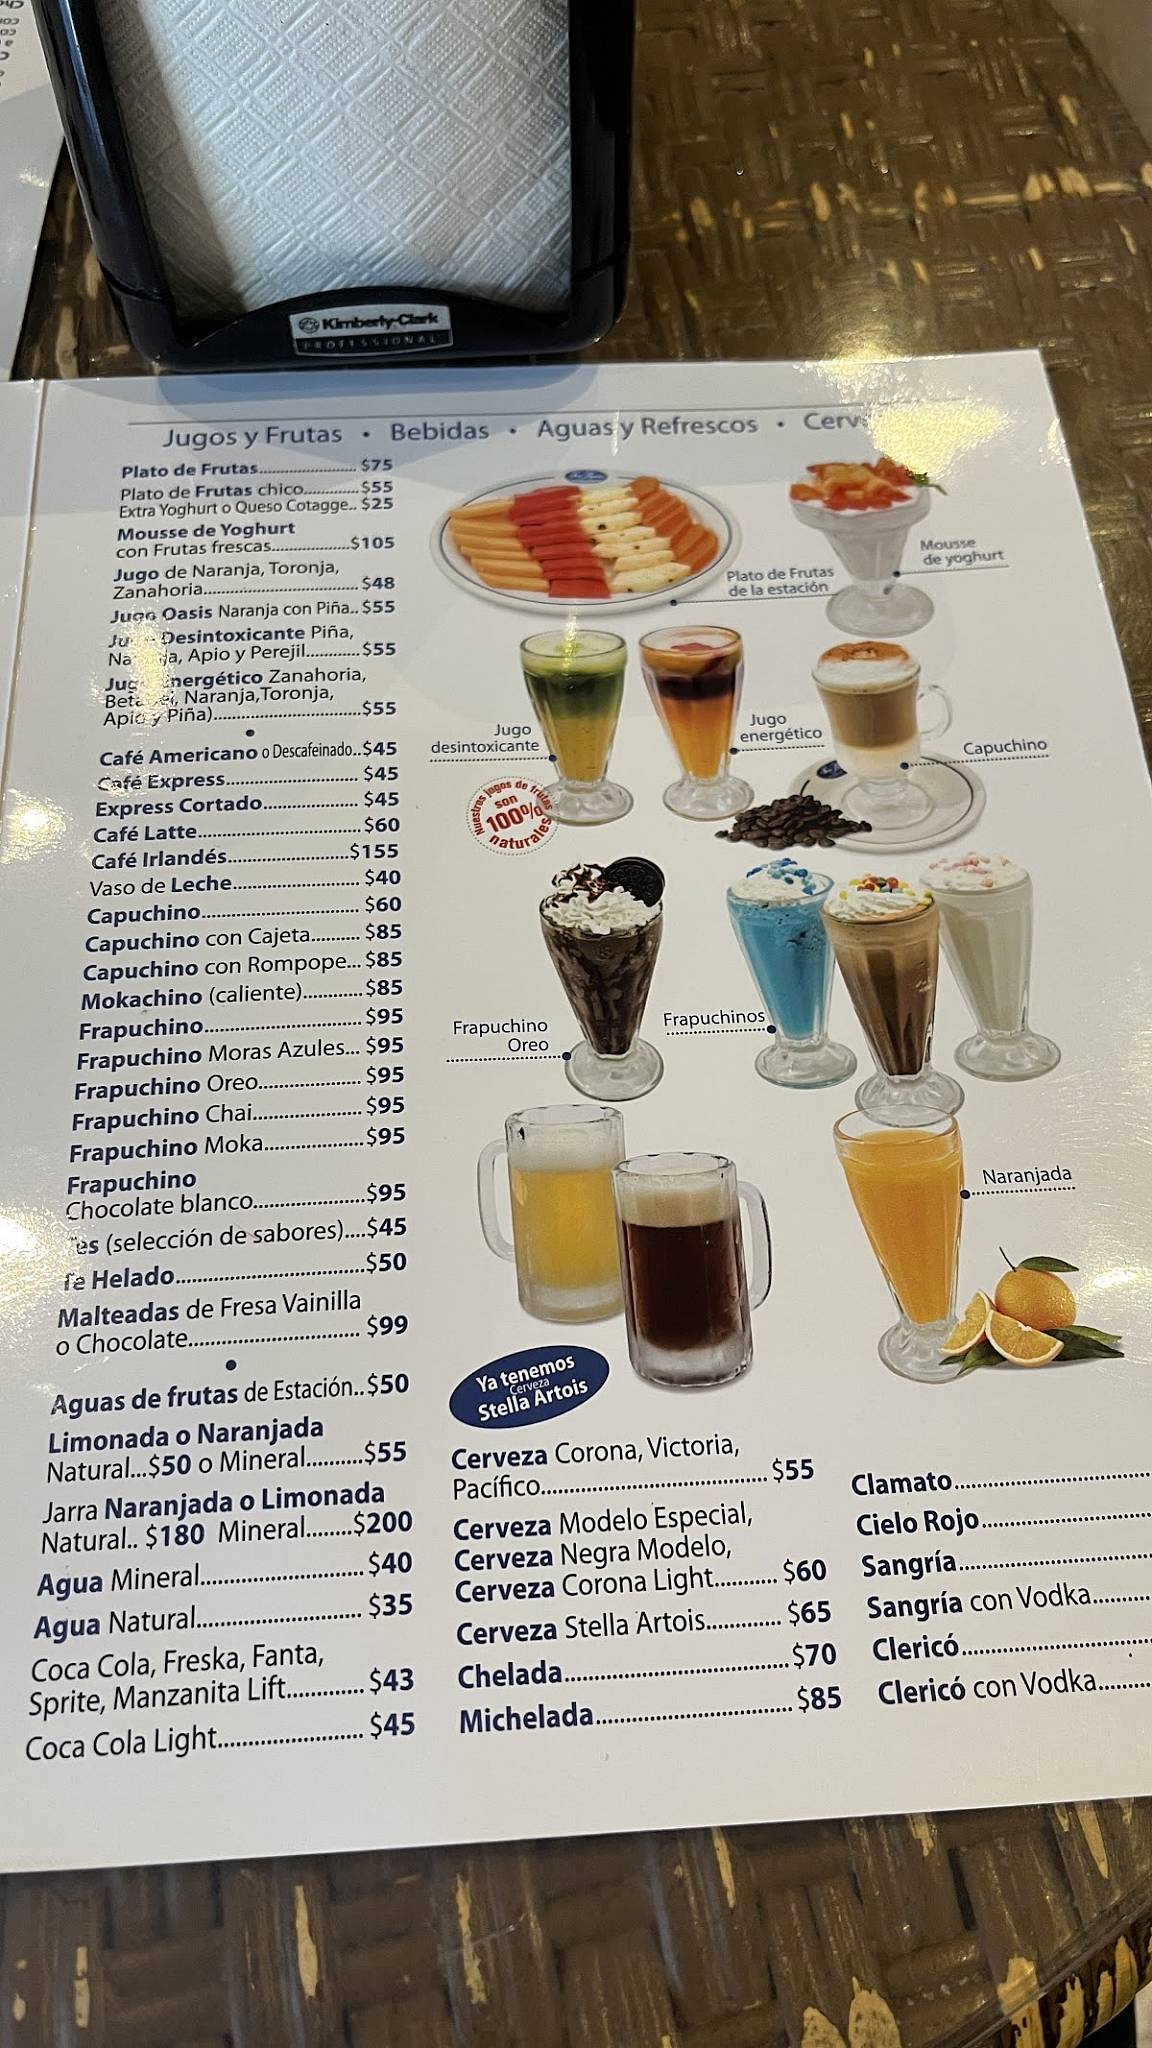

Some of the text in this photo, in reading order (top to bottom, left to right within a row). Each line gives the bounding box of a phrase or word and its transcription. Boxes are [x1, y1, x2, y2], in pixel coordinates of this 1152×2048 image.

[323, 312, 439, 330] Kimberly-Clark
[162, 429, 237, 450] Jugos
[244, 432, 257, 449] y
[265, 425, 342, 443] Frutas
[390, 422, 489, 441] Bebidas
[538, 418, 613, 440] Aguas
[619, 421, 634, 440] y
[642, 415, 758, 435] Refrescos
[121, 459, 393, 479] Plato de Frutas $75
[120, 481, 393, 501] Plato de Frutas chico $55
[119, 498, 393, 519] Extra Yoghurt o Queso Cotagge $25
[117, 522, 295, 541] Mousse de Yoghurt
[920, 538, 976, 552] Mousse
[116, 537, 395, 559] con Frutas frescas $105
[923, 549, 1004, 567] de yoghurt
[113, 561, 339, 584] Jugo de Naranja, Toronja,
[726, 567, 834, 583] Plato de Frutas
[112, 576, 395, 600] Zanahoria $48
[728, 580, 828, 597] de la estación
[162, 607, 213, 621] Oasis
[218, 604, 279, 619] Naranja
[283, 603, 312, 616] con
[317, 601, 351, 615] Piña
[362, 600, 395, 615] $55
[494, 724, 532, 738] Jugo
[749, 714, 787, 728] Jugo
[431, 740, 540, 754] desintoxicante
[740, 727, 822, 744] energético
[963, 739, 1048, 759] Capuchino
[100, 741, 397, 766] Café Americano o Descafeinado $45
[95, 791, 399, 819] Express Cortado $45
[471, 794, 487, 836] Nuestros
[515, 780, 528, 790] de
[530, 785, 553, 810] frutas
[494, 795, 518, 809] son
[94, 816, 400, 843] Café Latte $60
[486, 802, 543, 833] 100%
[489, 817, 552, 849] naturales
[91, 843, 399, 870] Café Irlandés $155
[90, 869, 401, 897] Vaso de Leche $40
[83, 952, 402, 983] Capuchino con Rompope $85
[81, 978, 403, 1011] Mokachino (caliente) $85
[453, 1019, 548, 1038] Frapuchino
[664, 1009, 765, 1029] Frapuchinos
[77, 1036, 404, 1072] Frapuchino Moras Azules $95
[508, 1038, 549, 1052] Oreo
[71, 1096, 405, 1133] Frapuchino Chai $95
[67, 1171, 196, 1197] Frapuchino
[982, 1165, 1072, 1185] Naranjada
[66, 1183, 406, 1220] Chocolate blanco $95
[57, 1289, 361, 1328] Malteadas de Fresa Vainilla
[56, 1315, 408, 1356] o Chocolate $99
[476, 1354, 575, 1393] Ya tenemos
[509, 1376, 550, 1397] Cerveza
[478, 1377, 588, 1421] Stella Artois
[49, 1416, 324, 1454] Limonada o Naranjada
[47, 1441, 407, 1484] Natural $50 o Mineral $55
[451, 1433, 739, 1470] Cerveza Corona, Victoria,
[453, 1457, 814, 1500] Pacífico $55
[851, 1472, 952, 1496] Clamato
[453, 1501, 752, 1540] Cerveza Modelo Especial,
[856, 1507, 979, 1536] Cielo Rojo
[861, 1550, 957, 1580] Sangría
[33, 1592, 413, 1643] Agua Natural $35
[872, 1632, 959, 1661] Clericó
[30, 1643, 324, 1682] Coca Cola, Freska, Fanta,
[28, 1667, 414, 1721] Sprite, Manzanita Lift $43
[459, 1685, 842, 1734] Michelada $85
